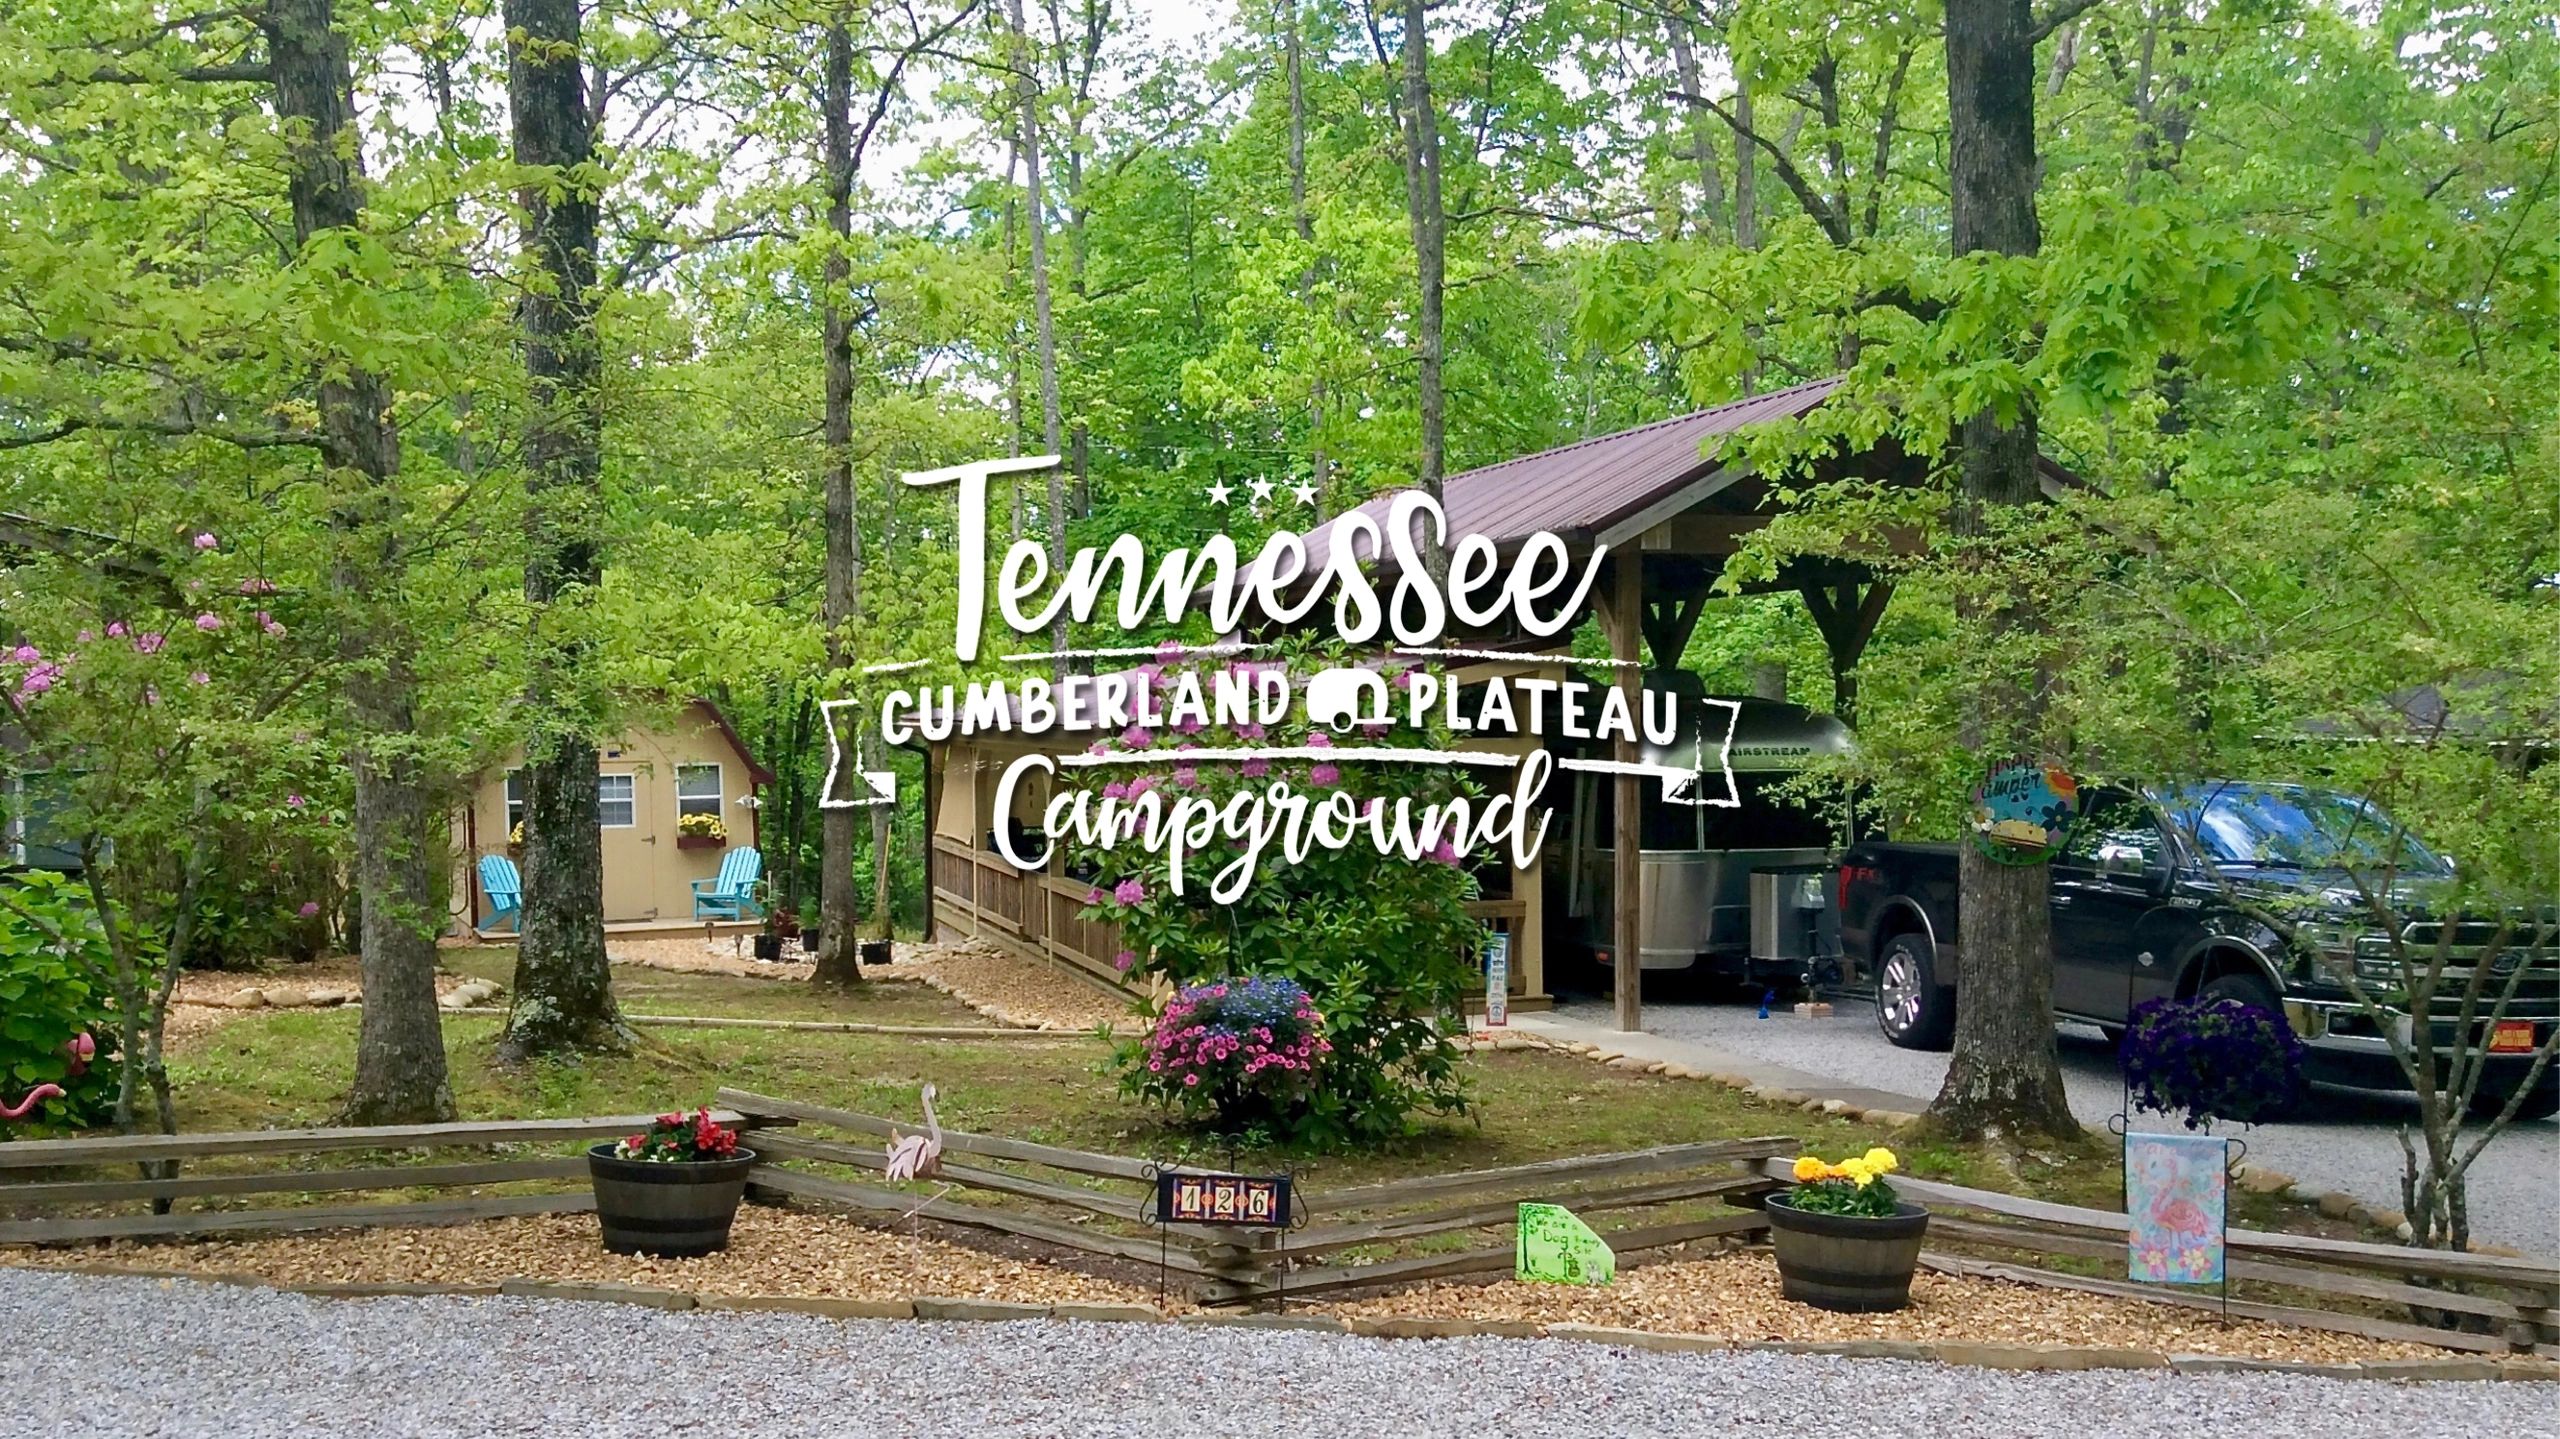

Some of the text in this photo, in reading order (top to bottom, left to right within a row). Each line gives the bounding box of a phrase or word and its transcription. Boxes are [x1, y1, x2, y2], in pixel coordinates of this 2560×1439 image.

[1728, 746, 1811, 757] AIRSTREAM
[1186, 1188, 1265, 1214] 126
[1543, 1229, 1569, 1252] Dog
